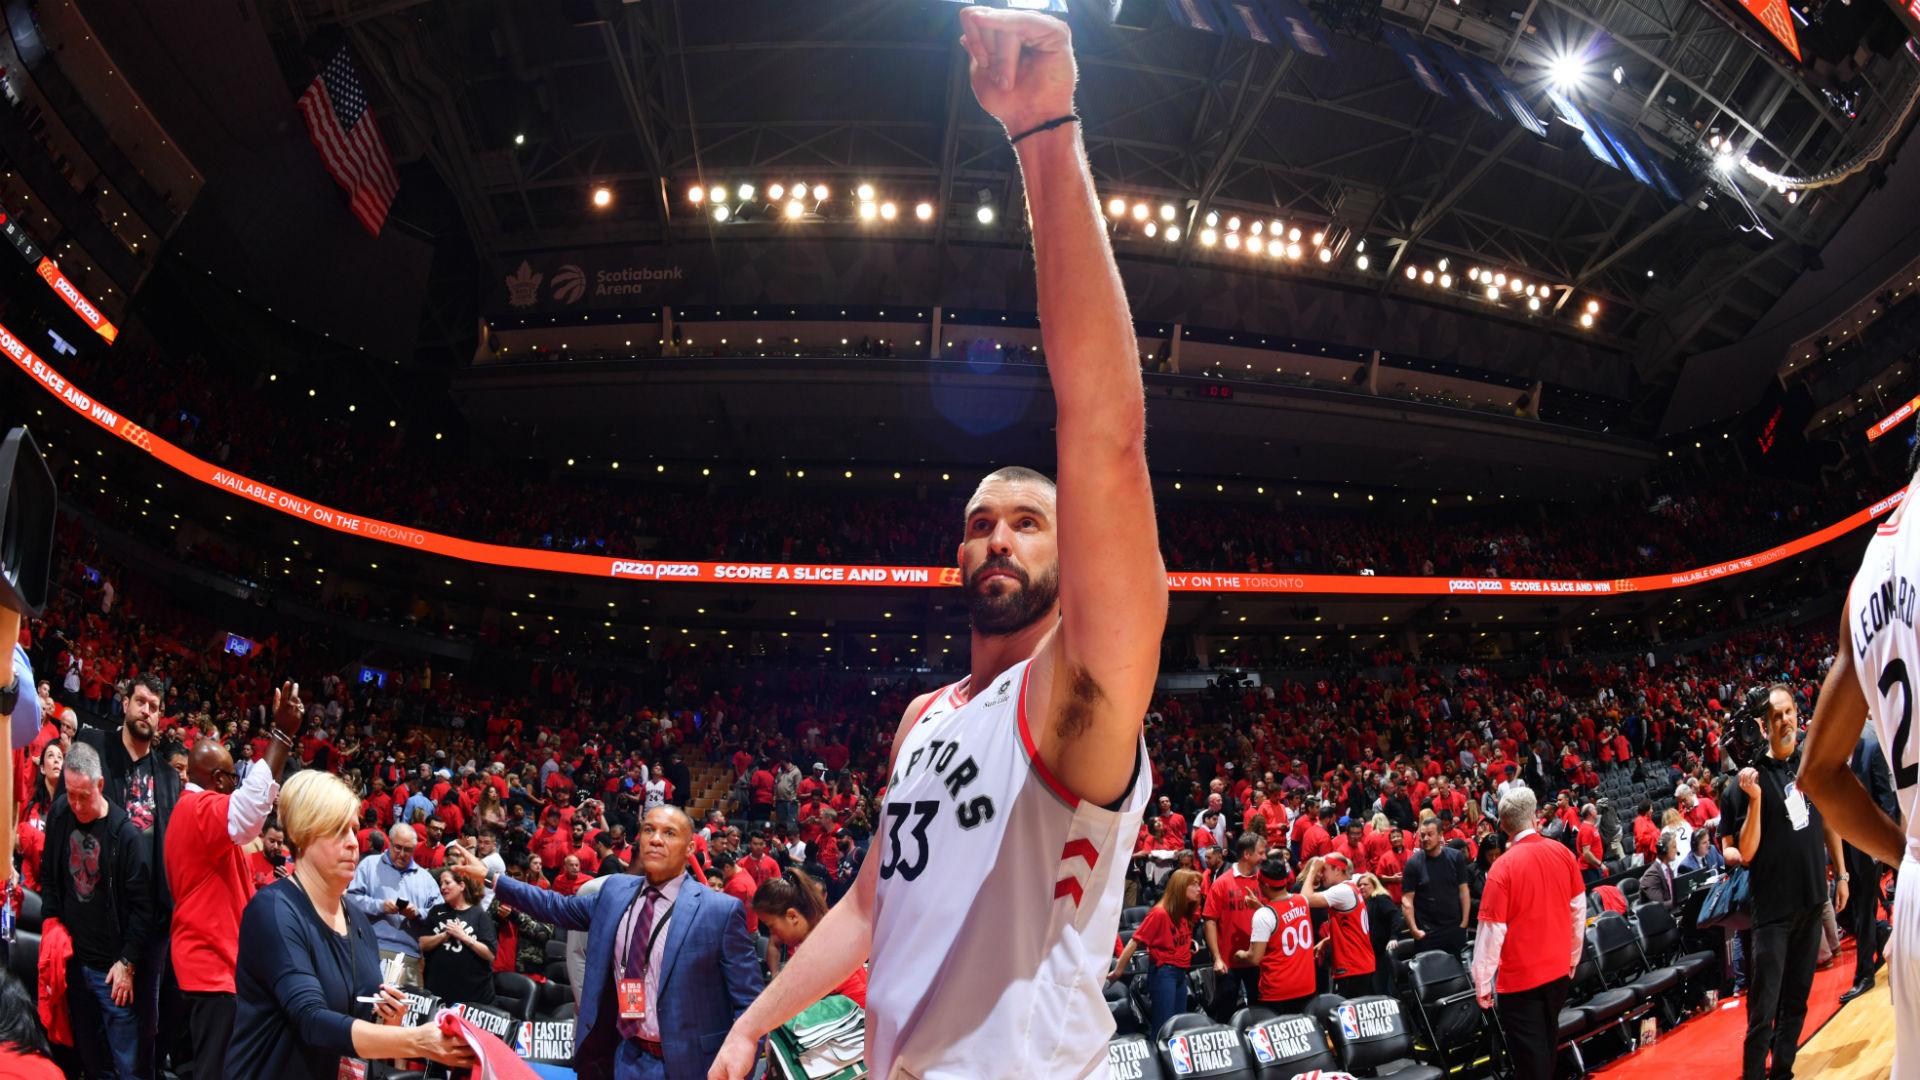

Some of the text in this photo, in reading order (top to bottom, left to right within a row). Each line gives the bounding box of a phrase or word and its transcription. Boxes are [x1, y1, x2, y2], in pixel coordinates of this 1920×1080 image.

[596, 266, 682, 282] Scotiabank
[54, 276, 101, 325] pizza pizza
[595, 283, 642, 296] Arena
[0, 328, 118, 428] ORE A SLICE AND WIN
[212, 471, 425, 545] AVAILABLE ONLY ON THE TORONTO
[611, 560, 929, 583] pizza pizza SCORE A SLICE AND WIN
[1672, 548, 1786, 584] AVAILABLE ONLY ON THE TORONTO
[1166, 576, 1304, 589] NLY ON THE TORONTO
[1449, 579, 1611, 592] pizza pizza SCORE A SLICE AND WIN
[1878, 658, 1919, 790] 2
[885, 740, 996, 831] APTORS
[880, 800, 940, 882] 33
[1281, 919, 1312, 956] 00
[465, 1006, 510, 1036] EASTERN
[1356, 999, 1400, 1020] EASTERN
[534, 1021, 574, 1041] EASTER
[1267, 1017, 1315, 1042] EASTERN
[1360, 1016, 1394, 1037] FINALS
[534, 1039, 571, 1060] FINALS
[1109, 1039, 1150, 1063] STERN
[1189, 1029, 1240, 1053] EASTERN
[1273, 1034, 1311, 1059] FINALS
[1109, 1060, 1143, 1080] NALS
[1193, 1048, 1233, 1072] FINALS
